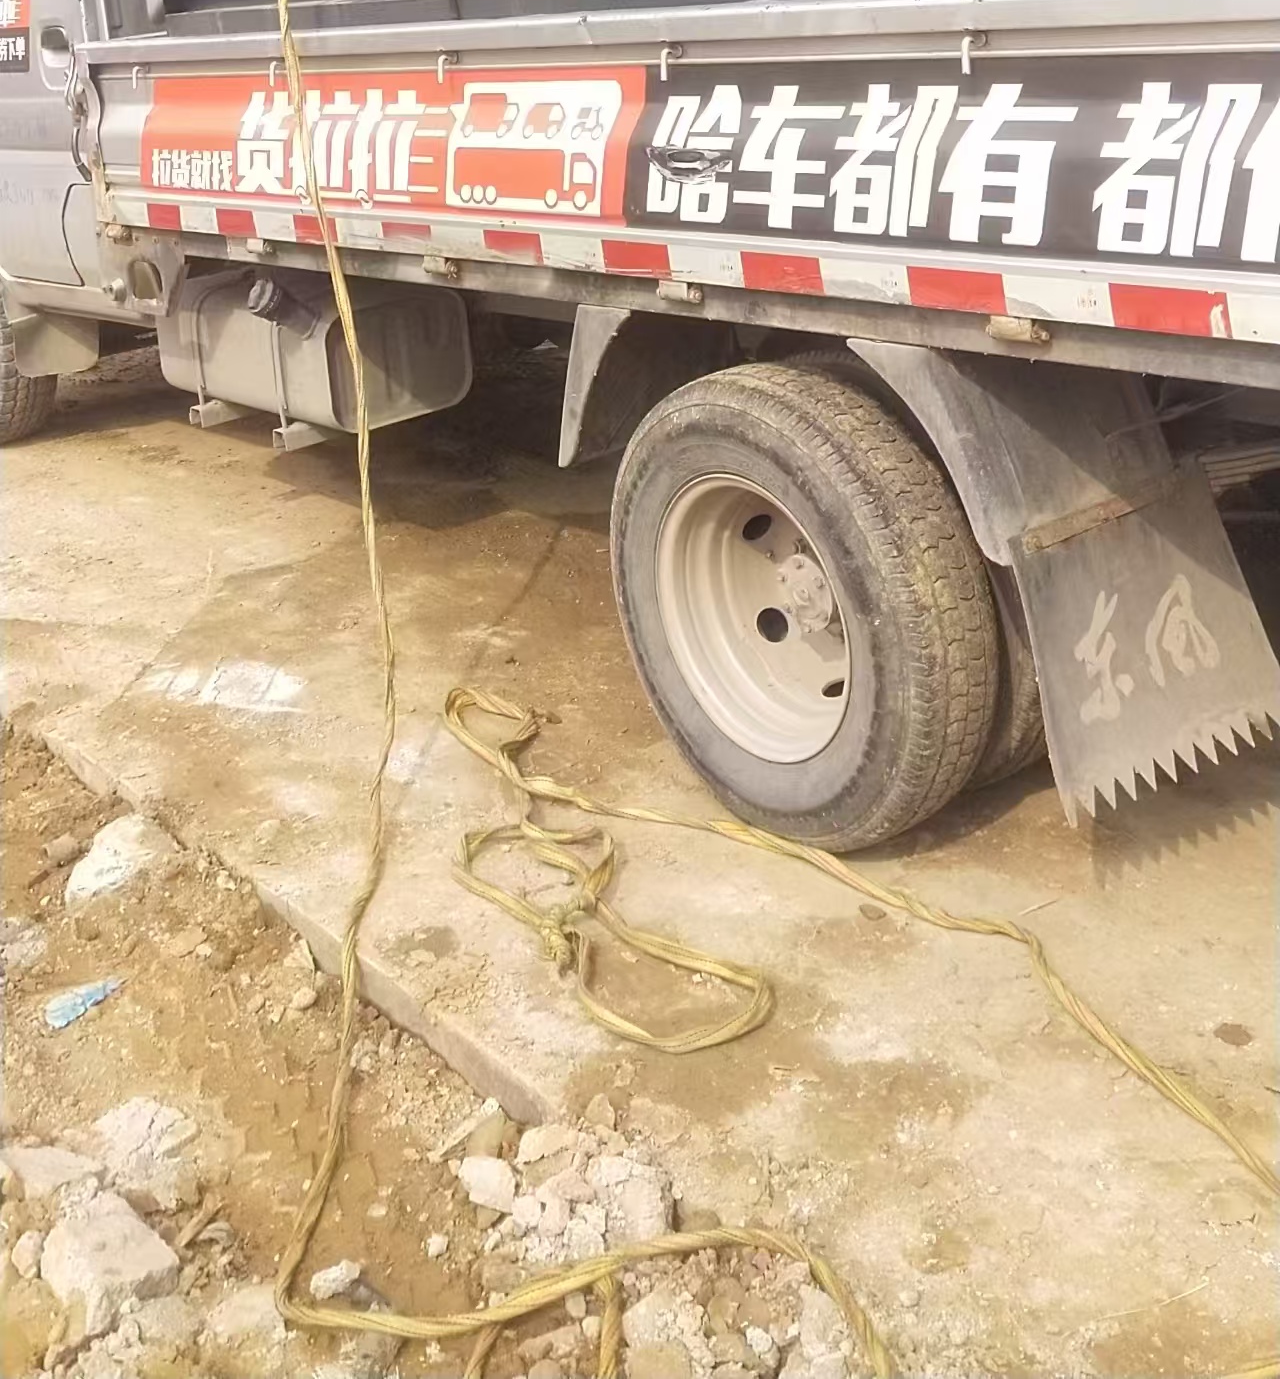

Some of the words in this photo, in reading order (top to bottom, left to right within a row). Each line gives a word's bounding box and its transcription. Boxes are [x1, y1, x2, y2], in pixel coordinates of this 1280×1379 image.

[151, 148, 234, 192] 拉货就找
[234, 89, 449, 203] 货拉拉
[1092, 82, 1280, 262] 都
